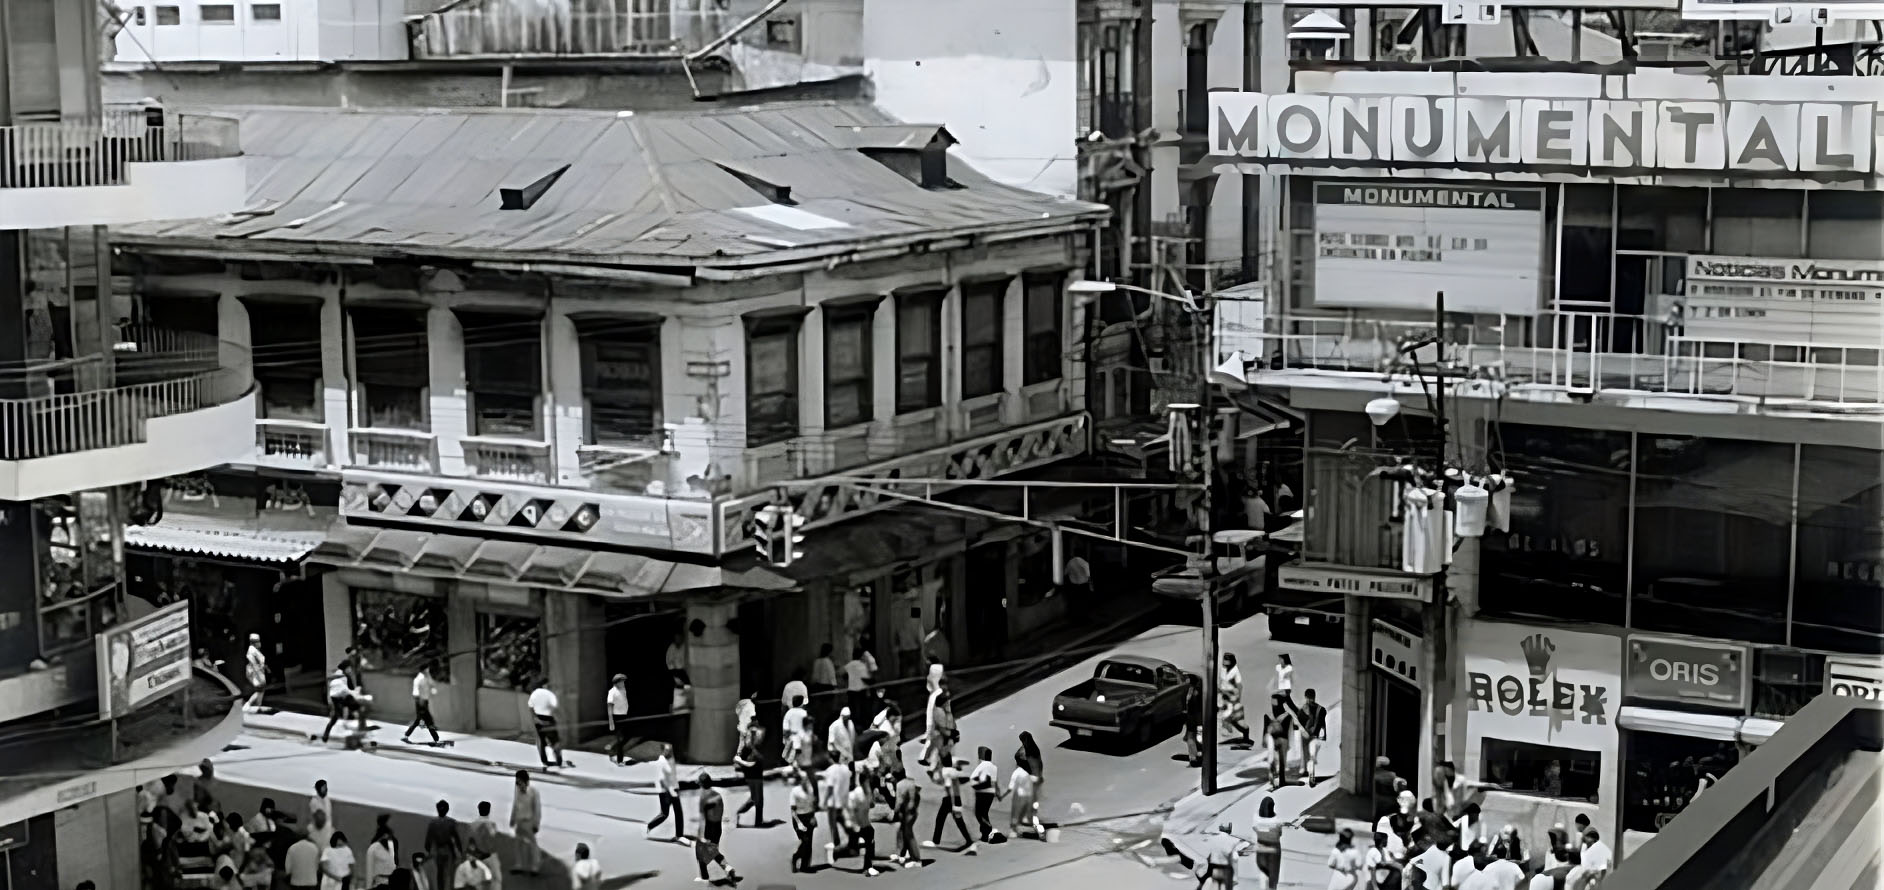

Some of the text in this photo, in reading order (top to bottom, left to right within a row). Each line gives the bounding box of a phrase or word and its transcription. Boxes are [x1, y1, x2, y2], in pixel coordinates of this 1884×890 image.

[1216, 102, 1856, 169] MONUMENTAL
[1344, 187, 1516, 209] MONUMENTAL
[1650, 658, 1719, 686] ORIS
[1467, 671, 1608, 726] ROLEX
